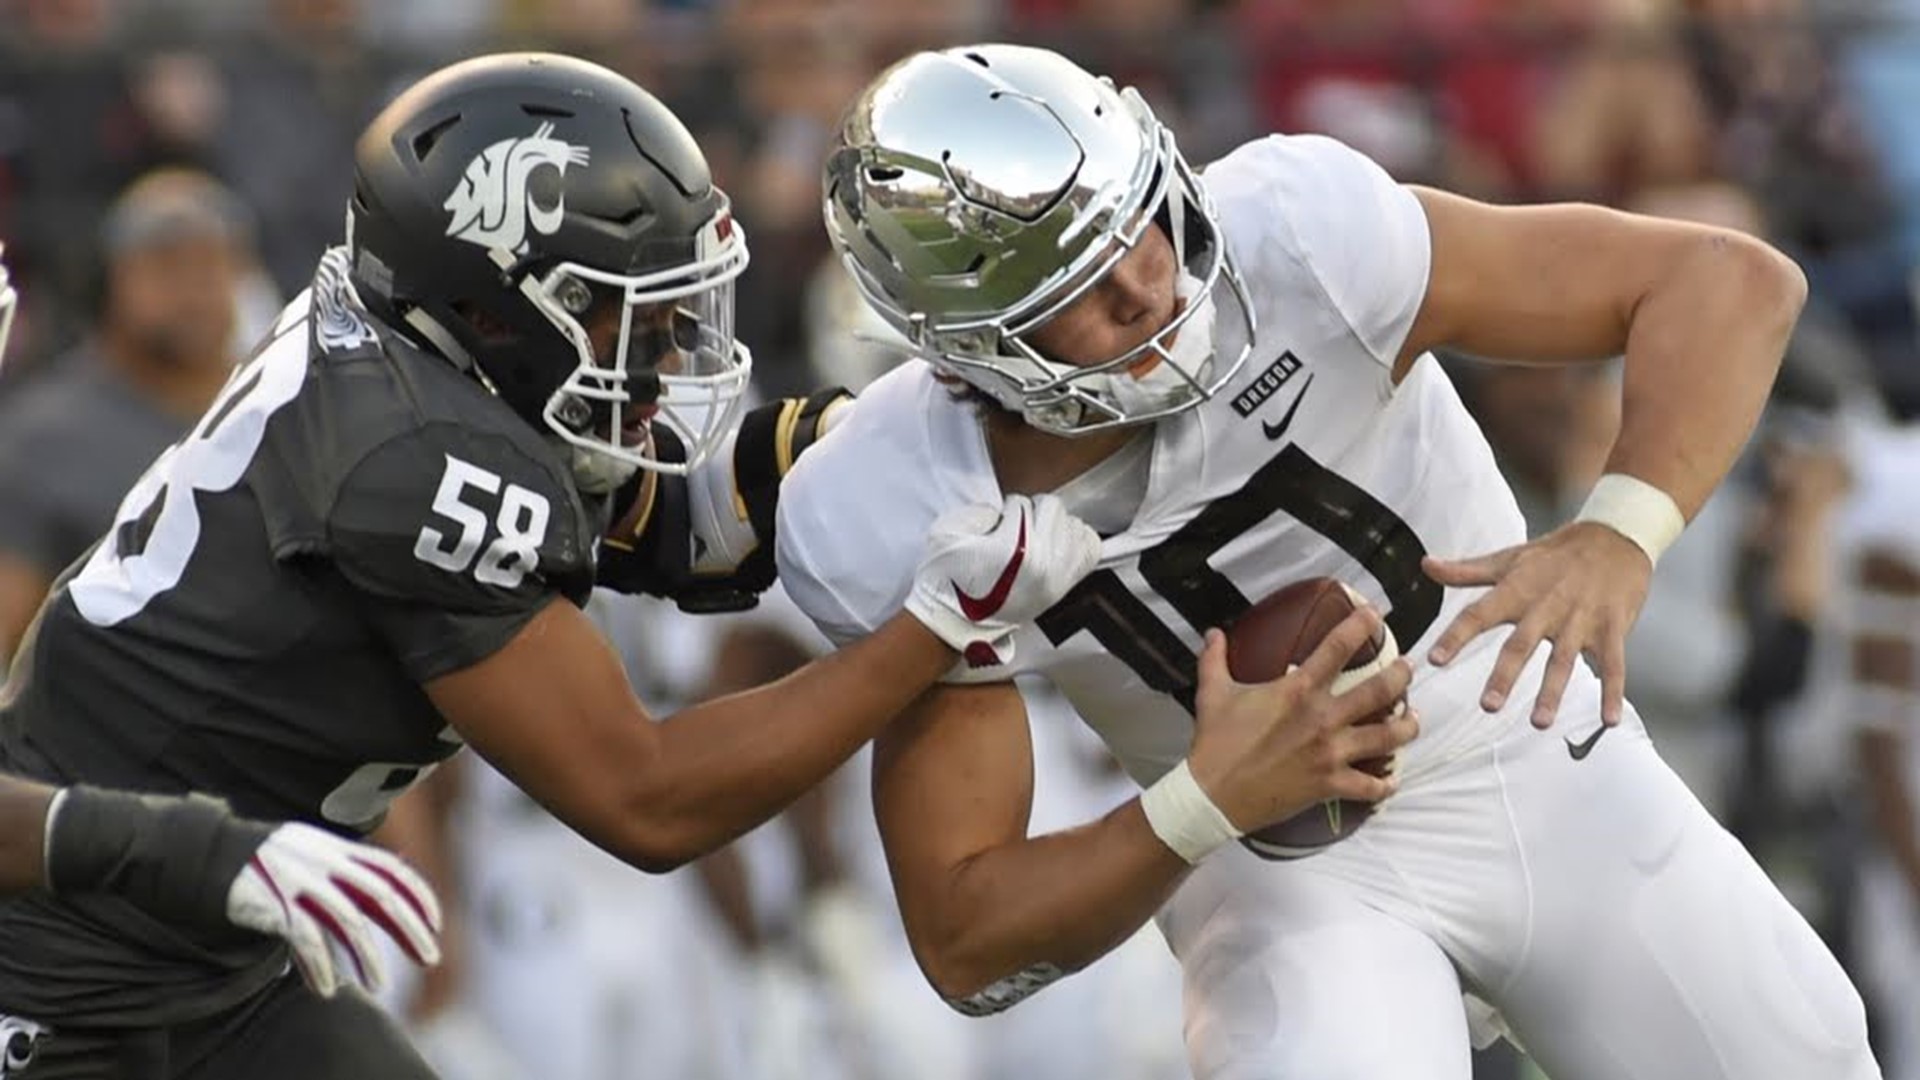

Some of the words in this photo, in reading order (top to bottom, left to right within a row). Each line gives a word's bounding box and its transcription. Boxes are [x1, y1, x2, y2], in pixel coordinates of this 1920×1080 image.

[1237, 355, 1297, 413] OREGON
[413, 452, 550, 588] 58
[1035, 441, 1444, 718] 10
